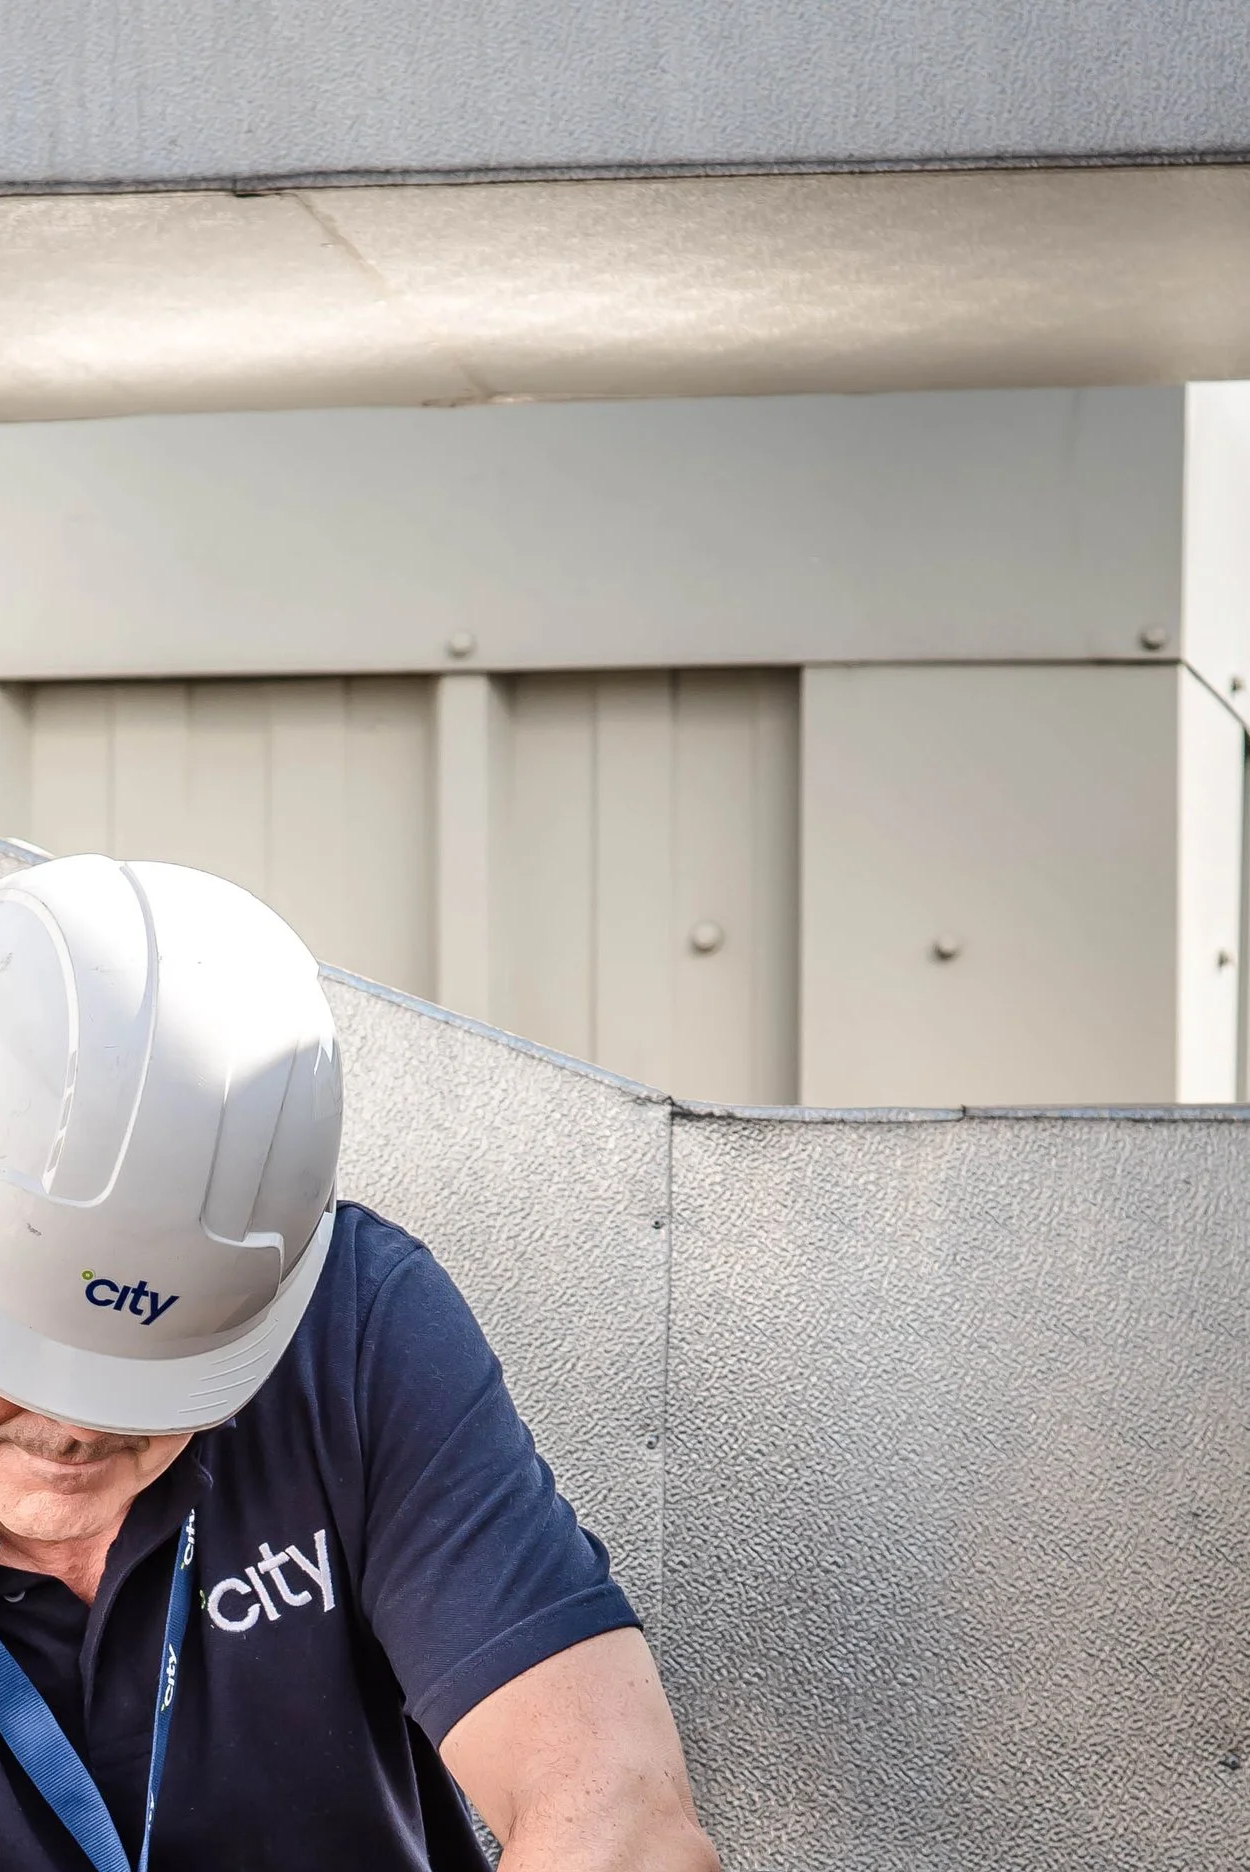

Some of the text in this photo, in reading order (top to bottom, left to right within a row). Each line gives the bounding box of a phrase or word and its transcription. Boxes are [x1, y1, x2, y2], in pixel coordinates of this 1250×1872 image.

[84, 1278, 180, 1326] city
[208, 1529, 336, 1632] city
[163, 1643, 177, 1707] city
